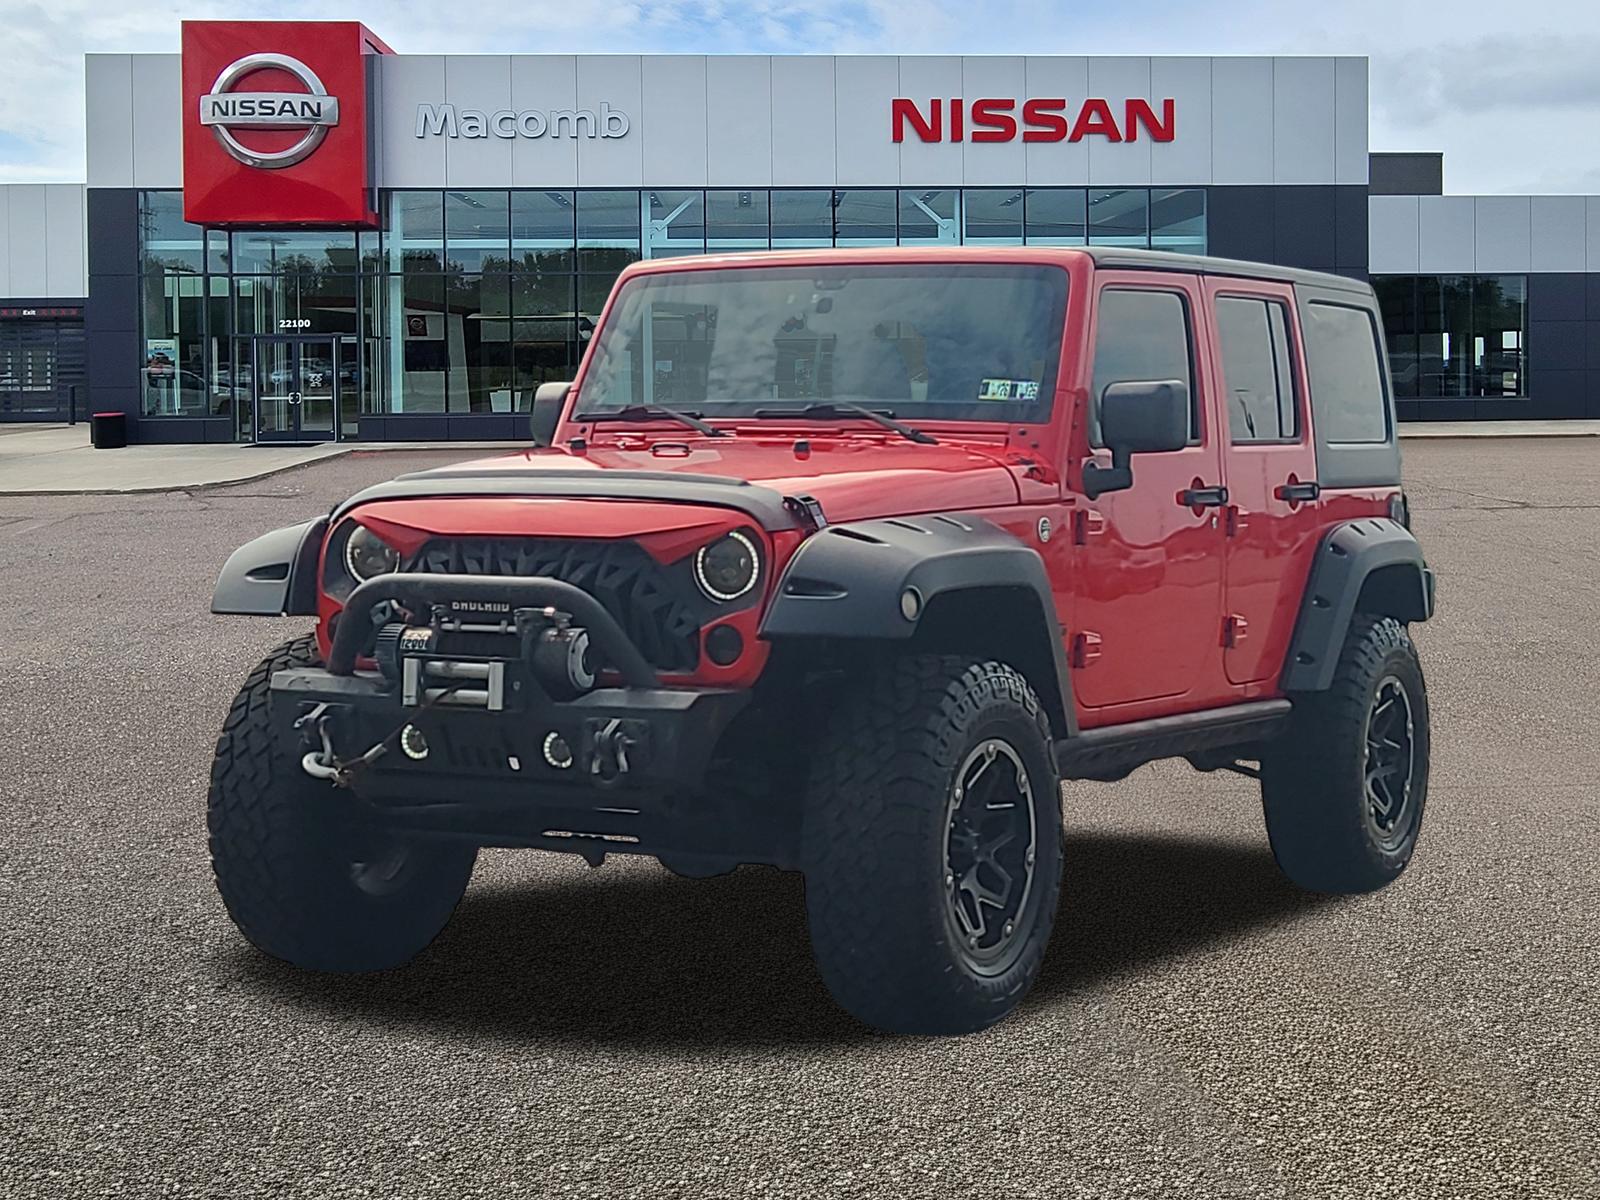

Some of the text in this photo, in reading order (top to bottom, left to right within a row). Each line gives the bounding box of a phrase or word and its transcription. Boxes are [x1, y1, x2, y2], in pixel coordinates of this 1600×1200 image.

[211, 100, 322, 118] NISSAN
[415, 101, 630, 139] Macomb
[892, 98, 1175, 143] NISSAN
[279, 319, 311, 328] 22100
